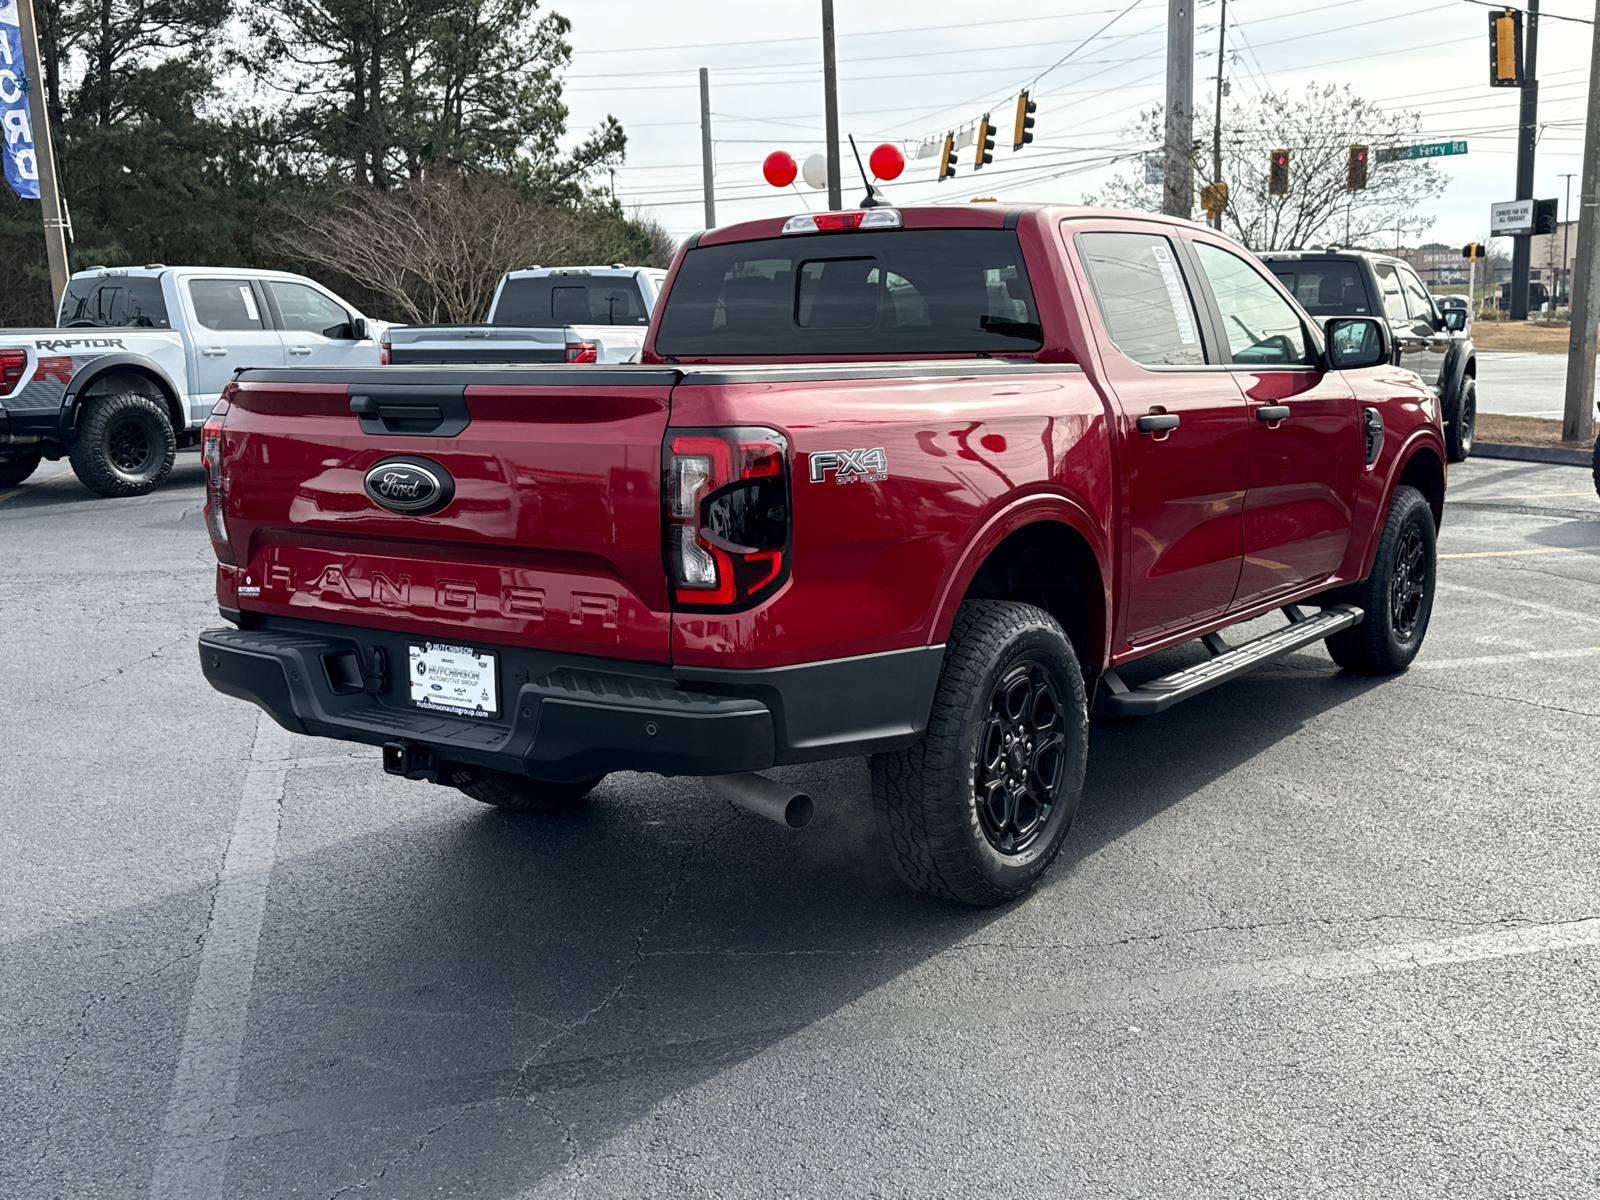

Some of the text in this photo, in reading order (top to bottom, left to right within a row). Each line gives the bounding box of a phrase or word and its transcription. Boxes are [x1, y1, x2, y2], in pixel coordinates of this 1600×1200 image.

[1420, 144, 1446, 156] Ferry
[1452, 142, 1464, 153] Rd
[35, 338, 128, 352] RAPTOR
[808, 447, 887, 483] FX4
[379, 472, 419, 497] Ford
[836, 473, 888, 485] OFF ROAD
[263, 560, 619, 629] RANGER
[433, 643, 474, 655] HUTCHINSON
[428, 665, 481, 680] HUTCHINSON
[429, 676, 460, 684] AUTOMOTIVE
[416, 701, 489, 718] Hutchinsonautogroup.com
